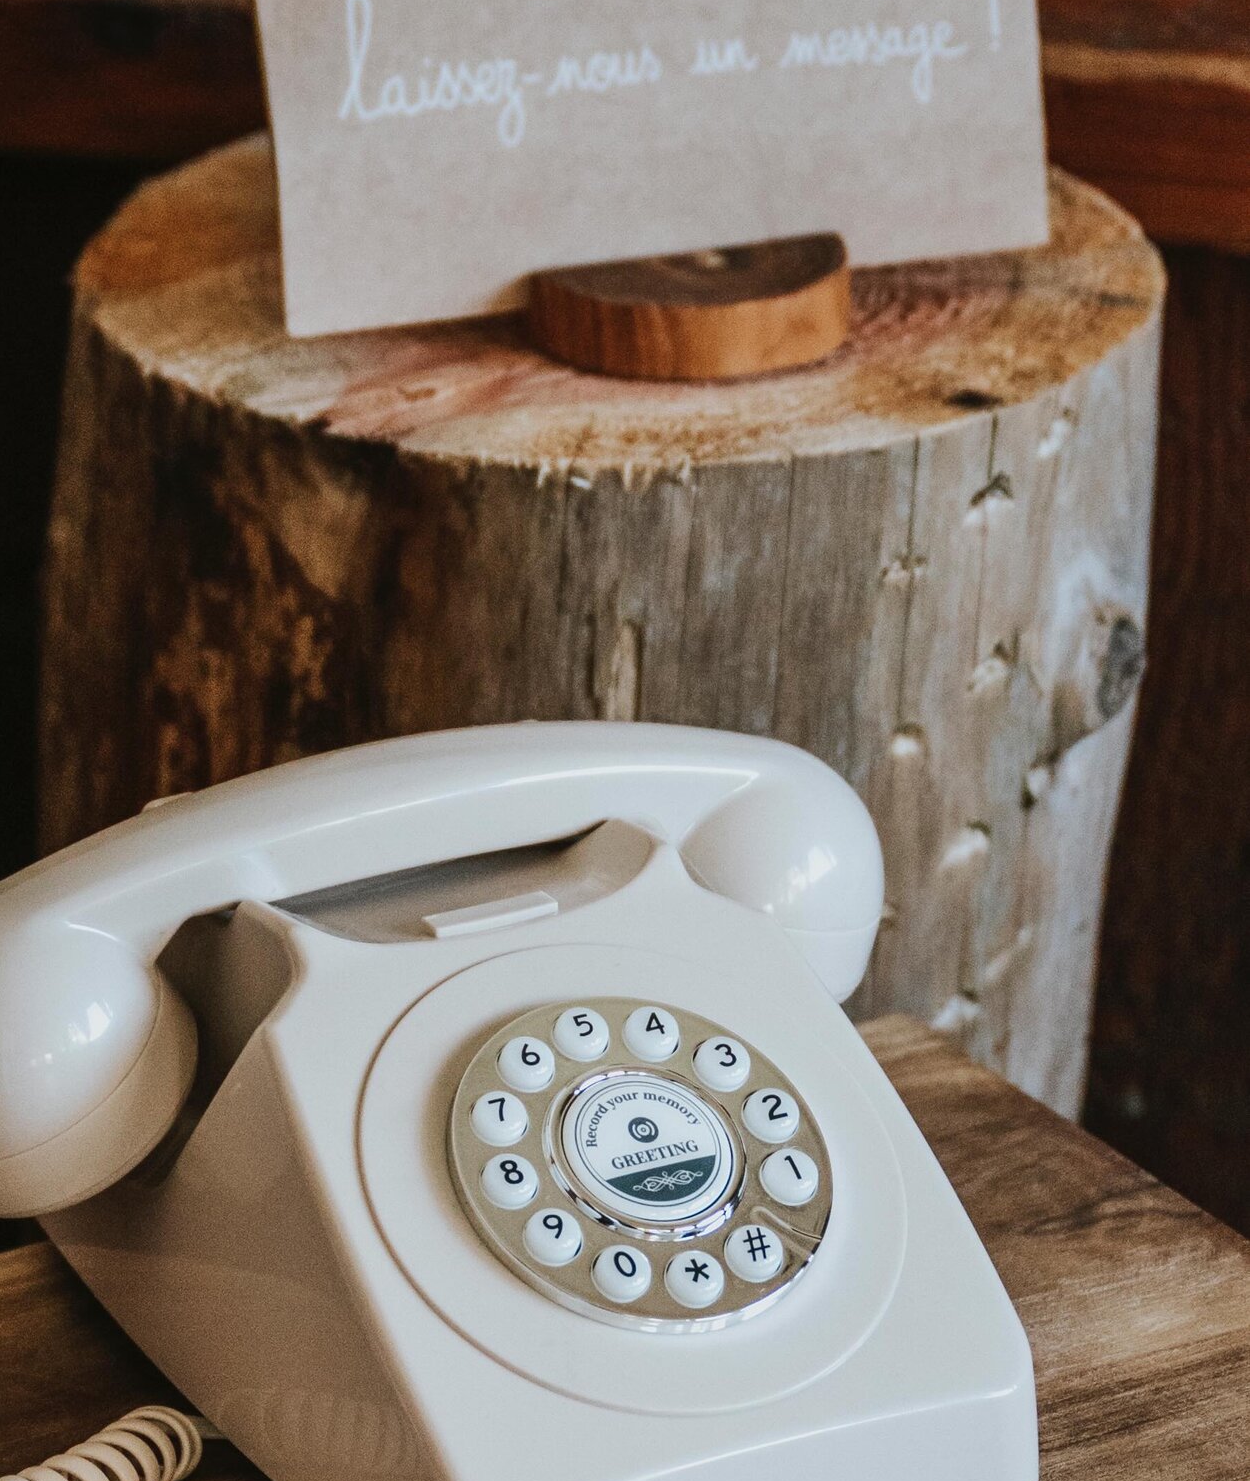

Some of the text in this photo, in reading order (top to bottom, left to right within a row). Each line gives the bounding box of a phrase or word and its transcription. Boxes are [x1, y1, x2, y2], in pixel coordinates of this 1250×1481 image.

[689, 36, 758, 76] un
[572, 1013, 594, 1037] 5
[645, 1012, 666, 1035] 4
[521, 1043, 541, 1066] 6
[714, 1043, 737, 1067] 3
[487, 1097, 506, 1122] 7
[586, 1091, 701, 1147] Record your memory
[761, 1094, 788, 1121] 2
[611, 1140, 699, 1170] GREETING
[784, 1156, 802, 1180] 1
[500, 1159, 525, 1185] 8
[542, 1213, 564, 1239] 9
[613, 1251, 637, 1278] 0
